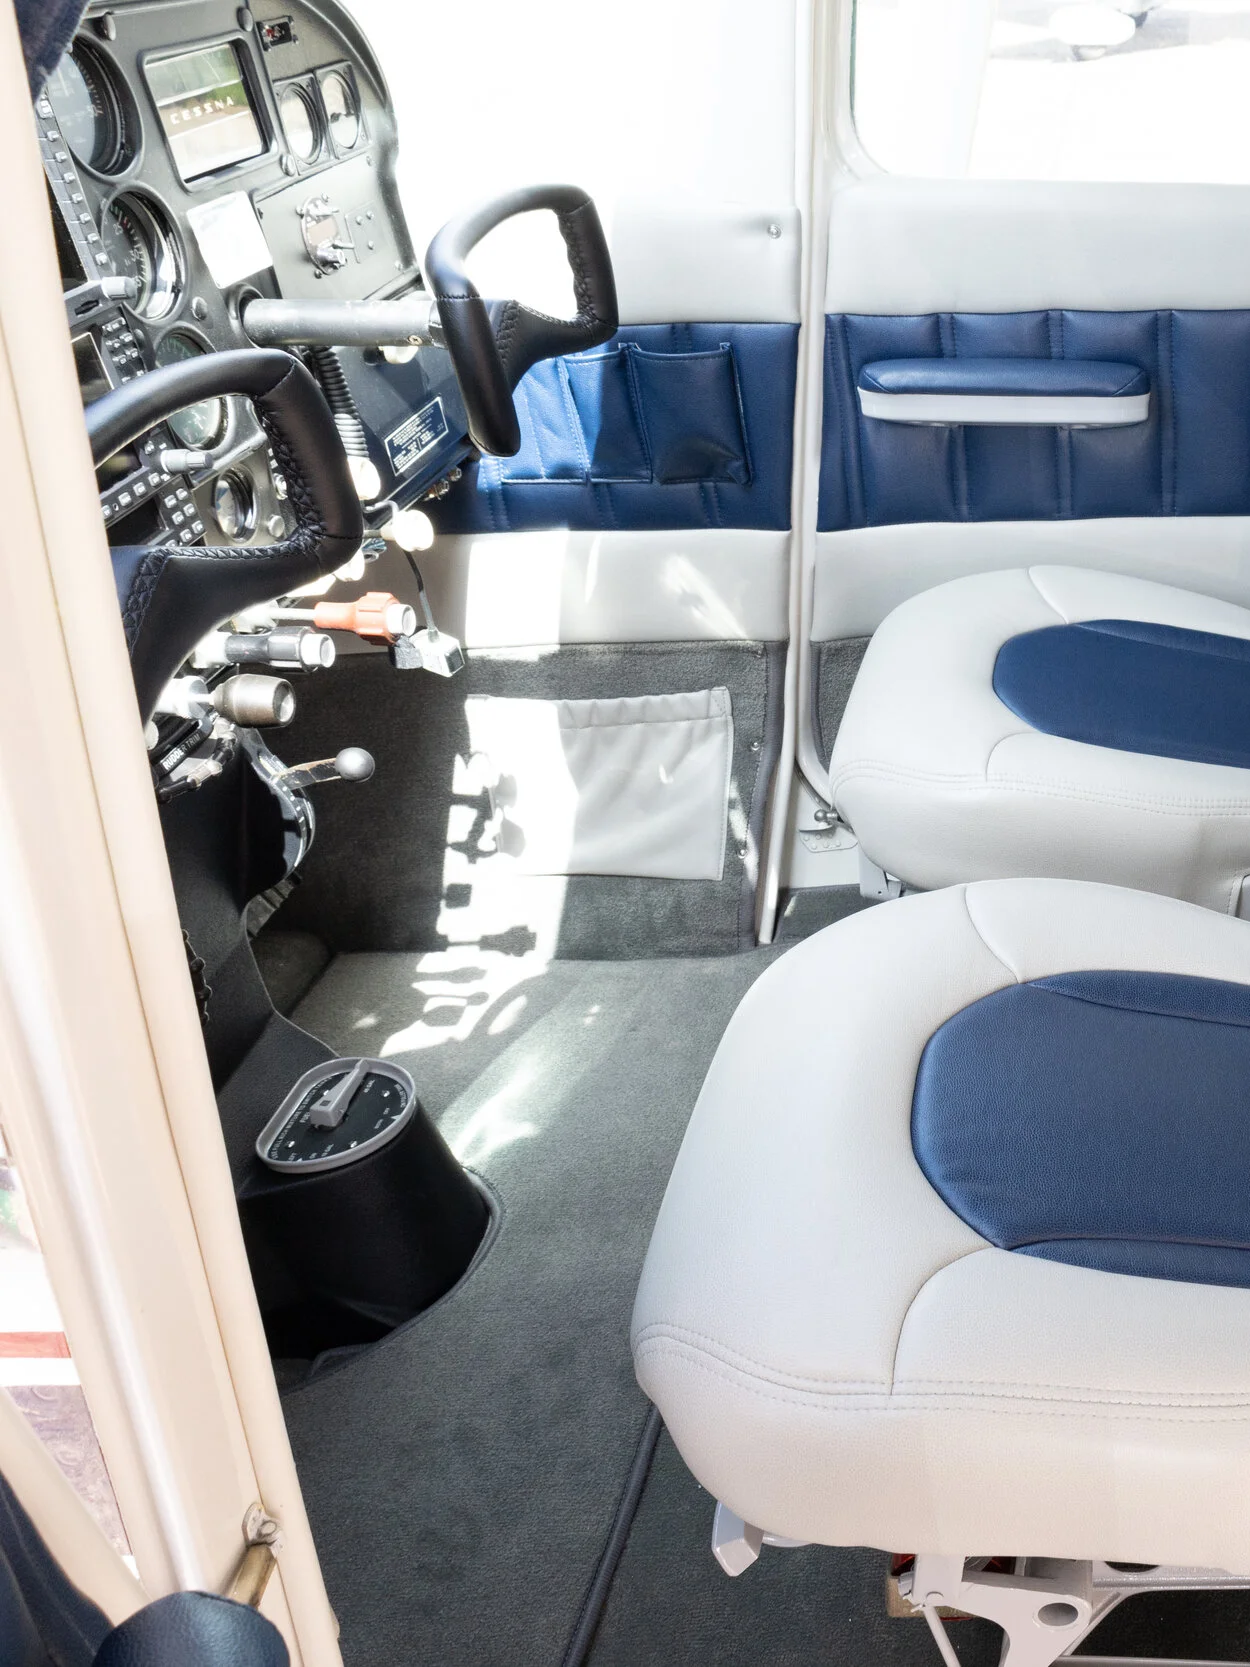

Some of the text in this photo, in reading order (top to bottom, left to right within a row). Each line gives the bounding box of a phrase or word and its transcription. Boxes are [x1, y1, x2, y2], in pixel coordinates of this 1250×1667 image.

[170, 96, 235, 125] CESSNA
[162, 733, 201, 771] RUDDER TRIM
